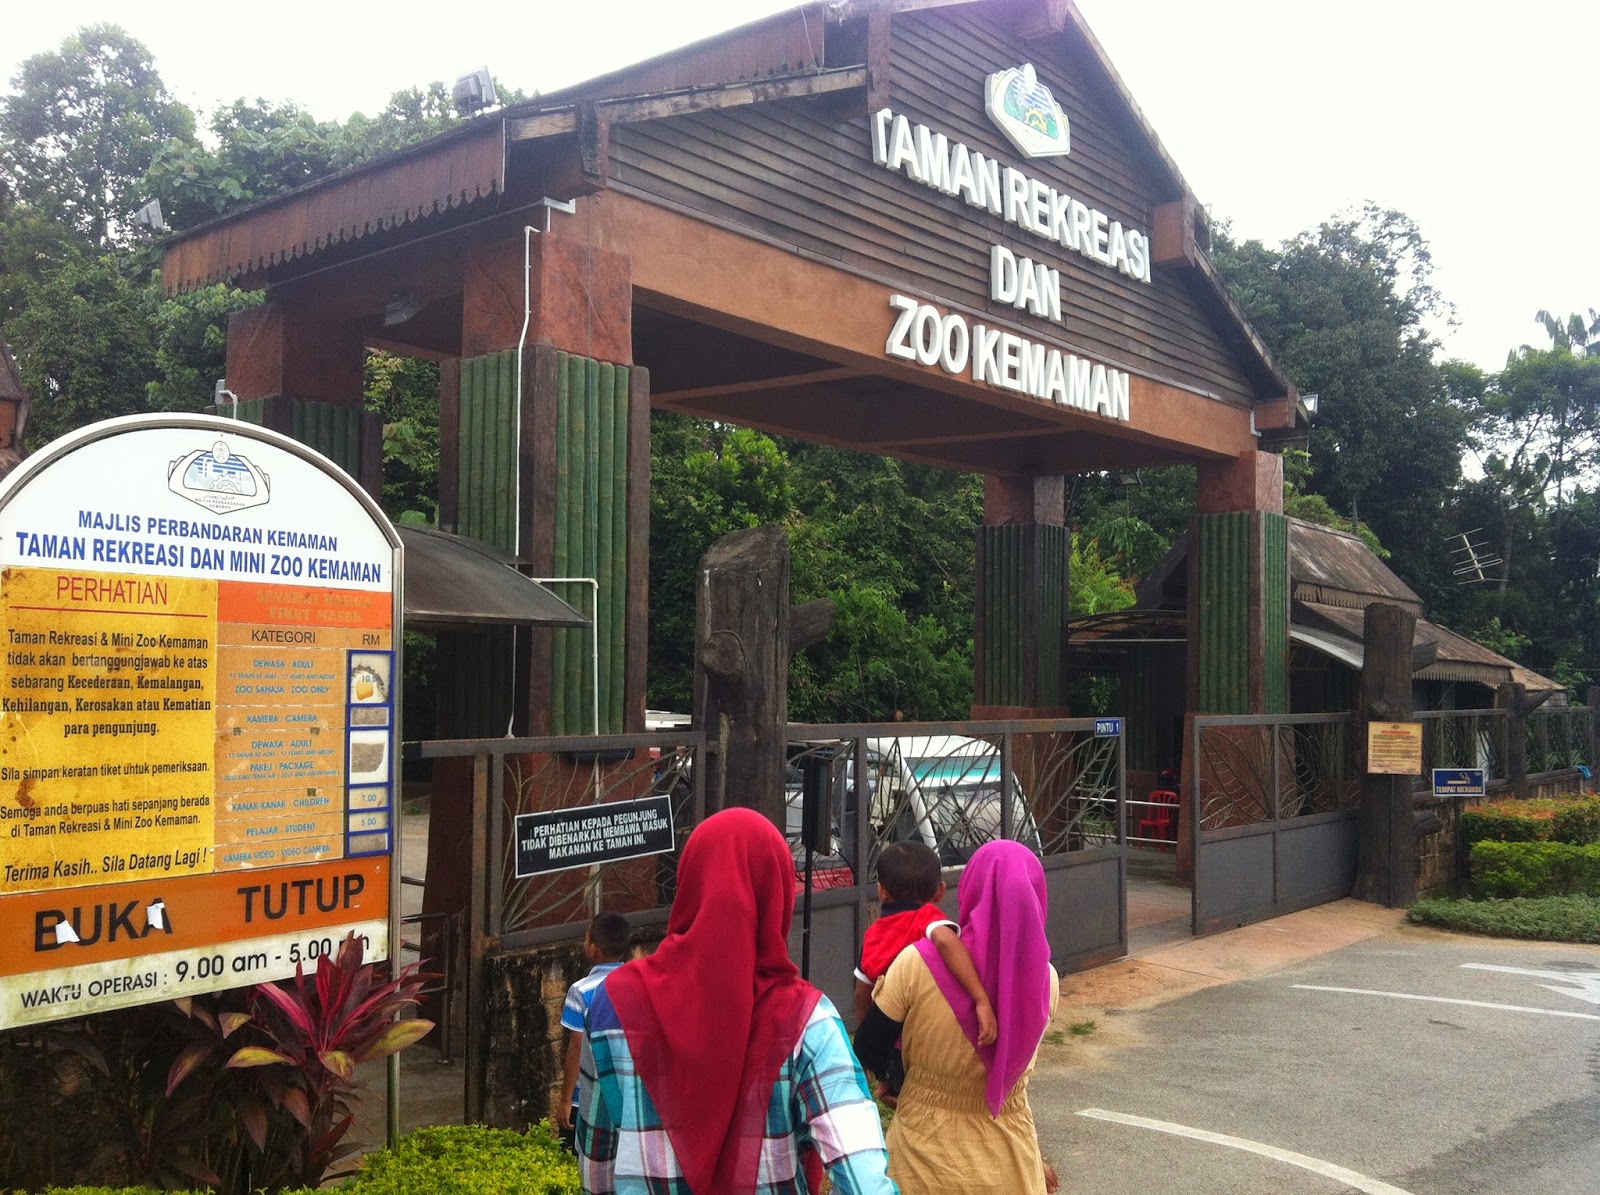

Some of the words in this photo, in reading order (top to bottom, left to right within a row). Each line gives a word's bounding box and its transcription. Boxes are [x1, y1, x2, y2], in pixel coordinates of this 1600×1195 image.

[870, 108, 1002, 215] TAMAN
[1003, 166, 1150, 283] REKREASI
[991, 245, 1061, 321] DAN
[886, 294, 969, 374] ZOO
[972, 325, 1129, 421] KEMAMAN
[79, 510, 141, 532] MAJLIS
[148, 518, 262, 544] PERBANDARAN
[268, 530, 337, 552] KEMAMAN
[16, 532, 85, 560] TAMAN
[93, 539, 184, 567] REKREASI
[191, 547, 224, 570] DAN
[230, 551, 265, 573] MINI
[271, 554, 302, 577] ZOO
[309, 558, 381, 582] KEMAMAN
[57, 576, 168, 605] PERHATIAN
[8, 629, 46, 644] Taman
[50, 631, 97, 646] Rekreasi
[101, 633, 108, 646] &
[112, 633, 133, 646] Mini
[137, 634, 156, 648] Zoo
[160, 635, 208, 649] Kemaman
[252, 630, 315, 643] KATEGORI
[363, 635, 380, 645] RM
[8, 652, 35, 666] tidak
[39, 653, 65, 666] akan
[72, 654, 170, 670] bertanggungjawab
[174, 656, 184, 668] ke
[187, 656, 208, 668] atas
[253, 660, 285, 668] DEWASA
[292, 660, 314, 668] ADULT
[11, 675, 64, 691] sebarang
[68, 675, 134, 691] Kecederaan,
[137, 676, 204, 691] Kemalangan,
[235, 685, 253, 693] ZOO
[256, 685, 284, 693] SAHAJA
[291, 685, 307, 693] ZOO
[310, 685, 329, 693] ONLY
[2, 698, 72, 714] Kehilangan,
[75, 698, 133, 711] Kerosakan
[137, 699, 159, 711] atau
[163, 698, 211, 711] Kematian
[64, 724, 88, 737] para
[92, 720, 160, 736] pengunjung.
[247, 715, 279, 723] KAMERA
[286, 714, 317, 722] CAMERA
[1097, 722, 1113, 733] PINTU
[1116, 722, 1119, 732] 1
[252, 741, 283, 749] DEWASA
[290, 740, 312, 748] ADULT
[1, 768, 20, 780] Sila
[23, 767, 59, 782] simpan
[62, 766, 97, 778] keratan
[100, 764, 121, 776] tiket
[124, 763, 149, 775] untuk
[152, 761, 209, 776] pemeriksaan.
[279, 761, 314, 769] PACKAGE
[0, 806, 41, 820] Semoga
[44, 803, 68, 817] anda
[71, 801, 110, 817] berpuas
[112, 800, 129, 812] hati
[132, 798, 178, 812] sepanjang
[180, 795, 210, 807] berada
[232, 800, 286, 811] KANAK-KANAK
[293, 798, 329, 807] CHILDREN
[11, 826, 20, 838] di
[23, 824, 56, 837] Taman
[60, 821, 100, 833] Rekreasi
[104, 819, 110, 831] &
[113, 818, 132, 830] Mini
[135, 816, 152, 828] Zoo
[155, 814, 200, 827] Kemaman.
[246, 826, 278, 836] PELAJAR
[285, 823, 316, 832] STUDENT
[534, 821, 580, 837] PERHATIAN
[582, 816, 612, 830] KEPADA
[614, 809, 658, 824] PEGUNJUNG
[522, 838, 546, 851] TIDAK
[549, 829, 602, 846] DIBENARKAN
[603, 823, 641, 838] MEMBAWA
[643, 818, 668, 832] MASUK
[224, 854, 252, 862] KAMERA
[255, 851, 275, 859] VIDEO
[281, 848, 301, 856] VIDEO
[303, 845, 330, 855] CAMERA
[550, 844, 591, 859] MAKANAN
[593, 841, 603, 851] KE
[606, 836, 633, 849] TAMAN
[634, 834, 646, 845] INI.
[5, 864, 49, 882] Terima
[54, 859, 98, 877] Kasih..
[102, 855, 124, 872] Sila
[129, 852, 171, 871] Datang
[35, 898, 173, 952] BUKA
[238, 873, 365, 923] TUTUP
[21, 984, 81, 1009] WAKTU
[88, 972, 157, 996] OPERASI
[176, 955, 224, 982] 9.00
[232, 953, 267, 972] am
[289, 938, 332, 963] 5.00
